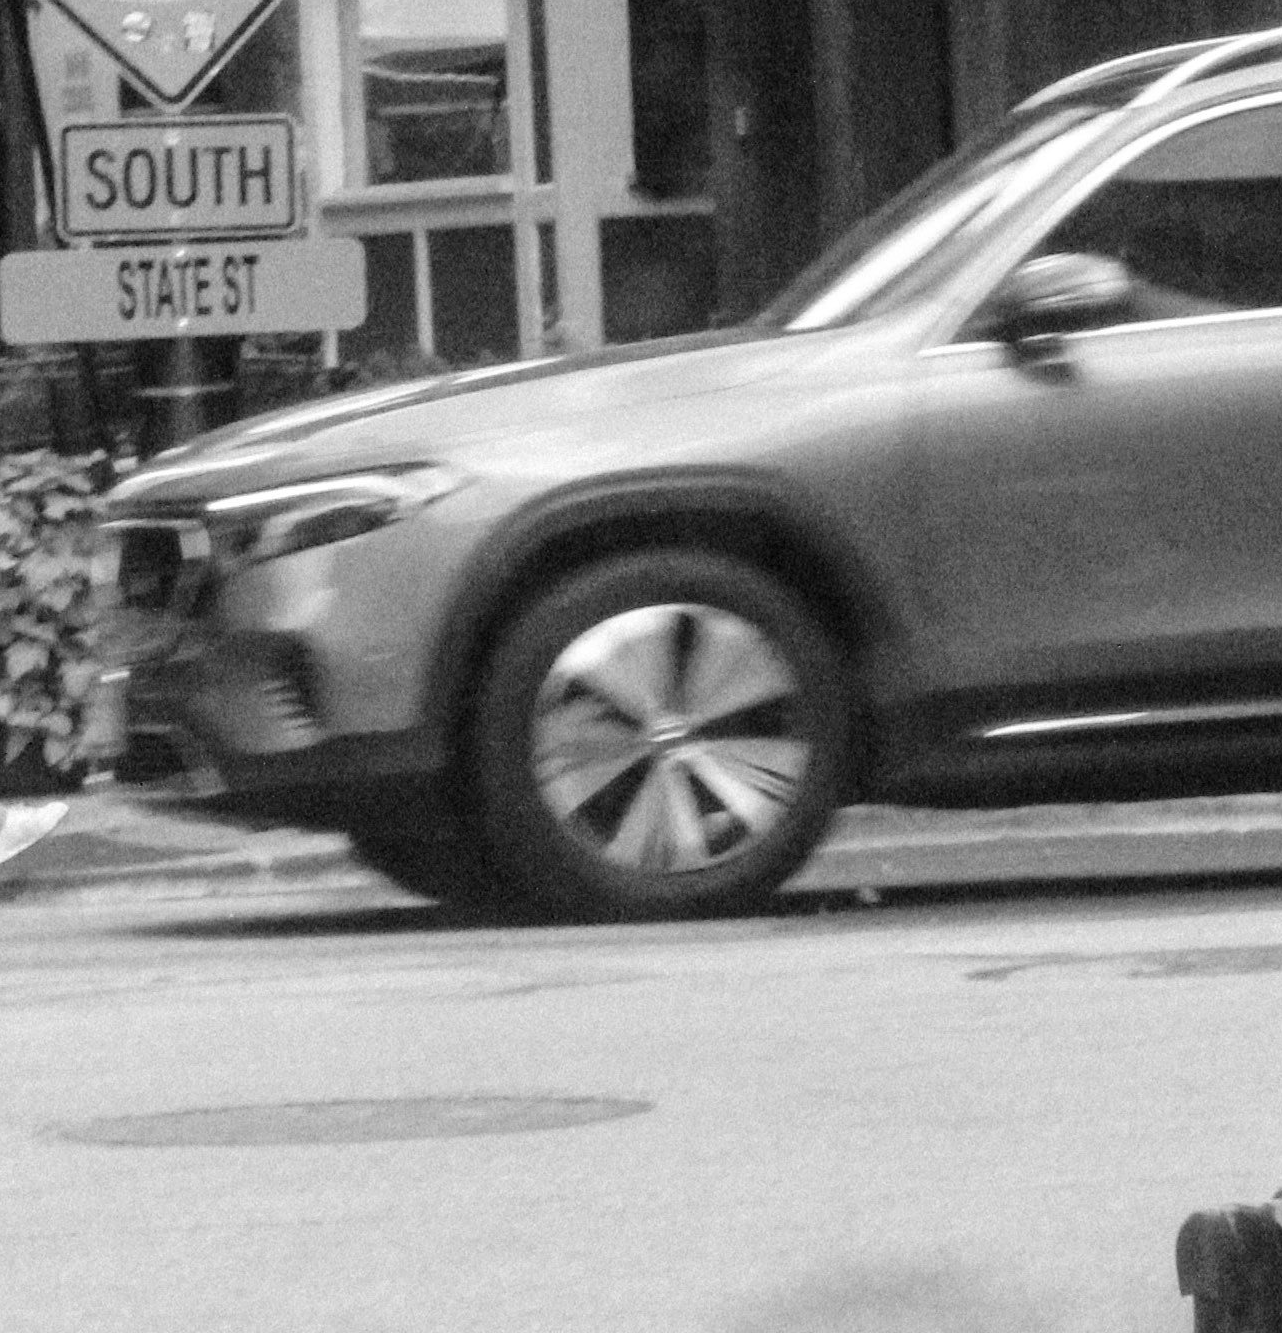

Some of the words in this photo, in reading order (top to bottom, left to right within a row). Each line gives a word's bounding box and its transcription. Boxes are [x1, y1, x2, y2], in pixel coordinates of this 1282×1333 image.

[87, 146, 273, 213] SOUTH
[120, 257, 212, 321] STATE
[222, 253, 259, 316] ST
